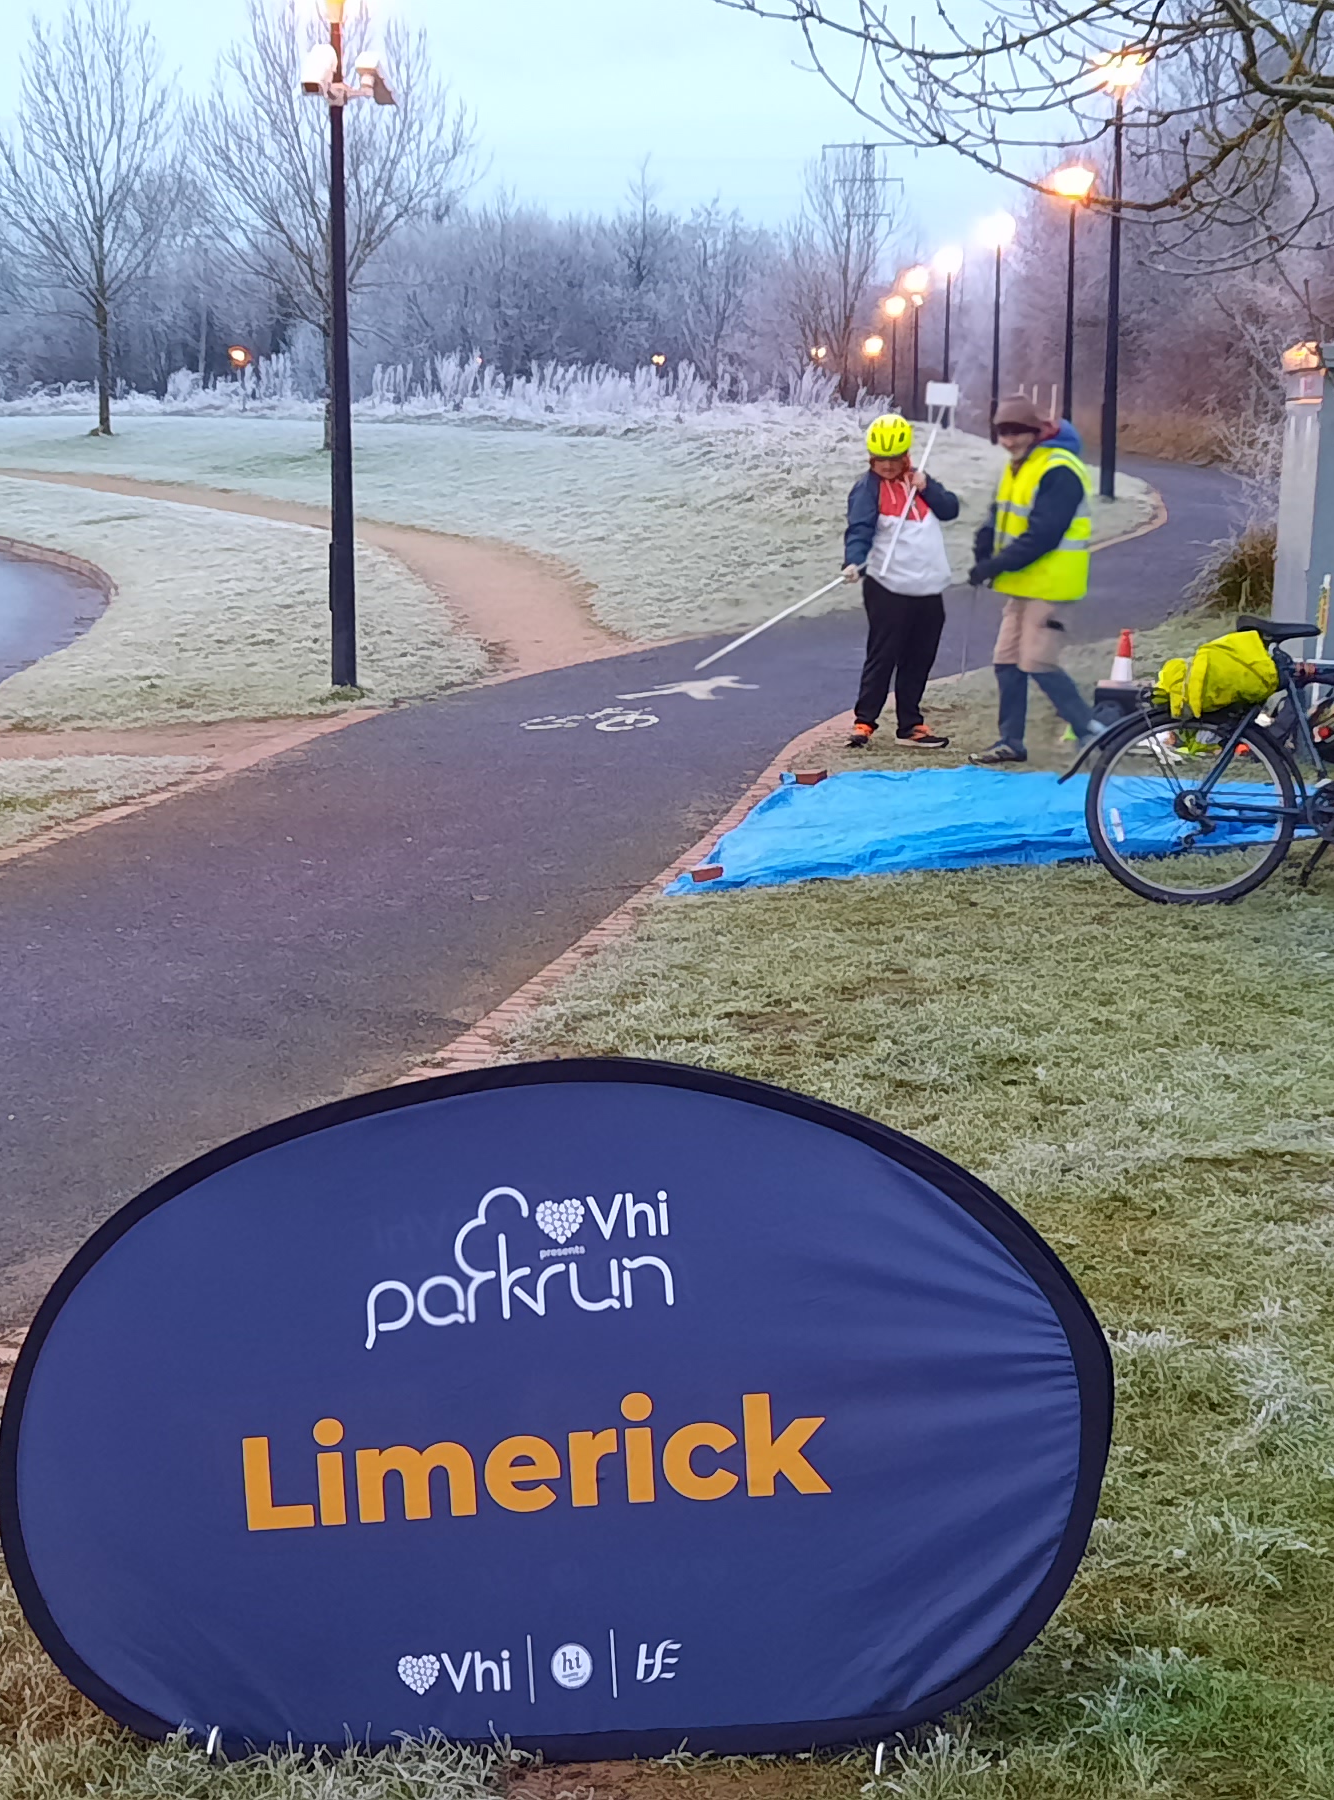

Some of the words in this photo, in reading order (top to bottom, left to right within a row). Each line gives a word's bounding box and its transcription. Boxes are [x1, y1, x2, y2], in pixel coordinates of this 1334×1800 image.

[585, 1190, 670, 1241] Vhi
[539, 1244, 586, 1261] presents
[365, 1231, 675, 1351] parkrun
[241, 1391, 833, 1532] Limerick
[440, 1648, 512, 1694] Vhi
